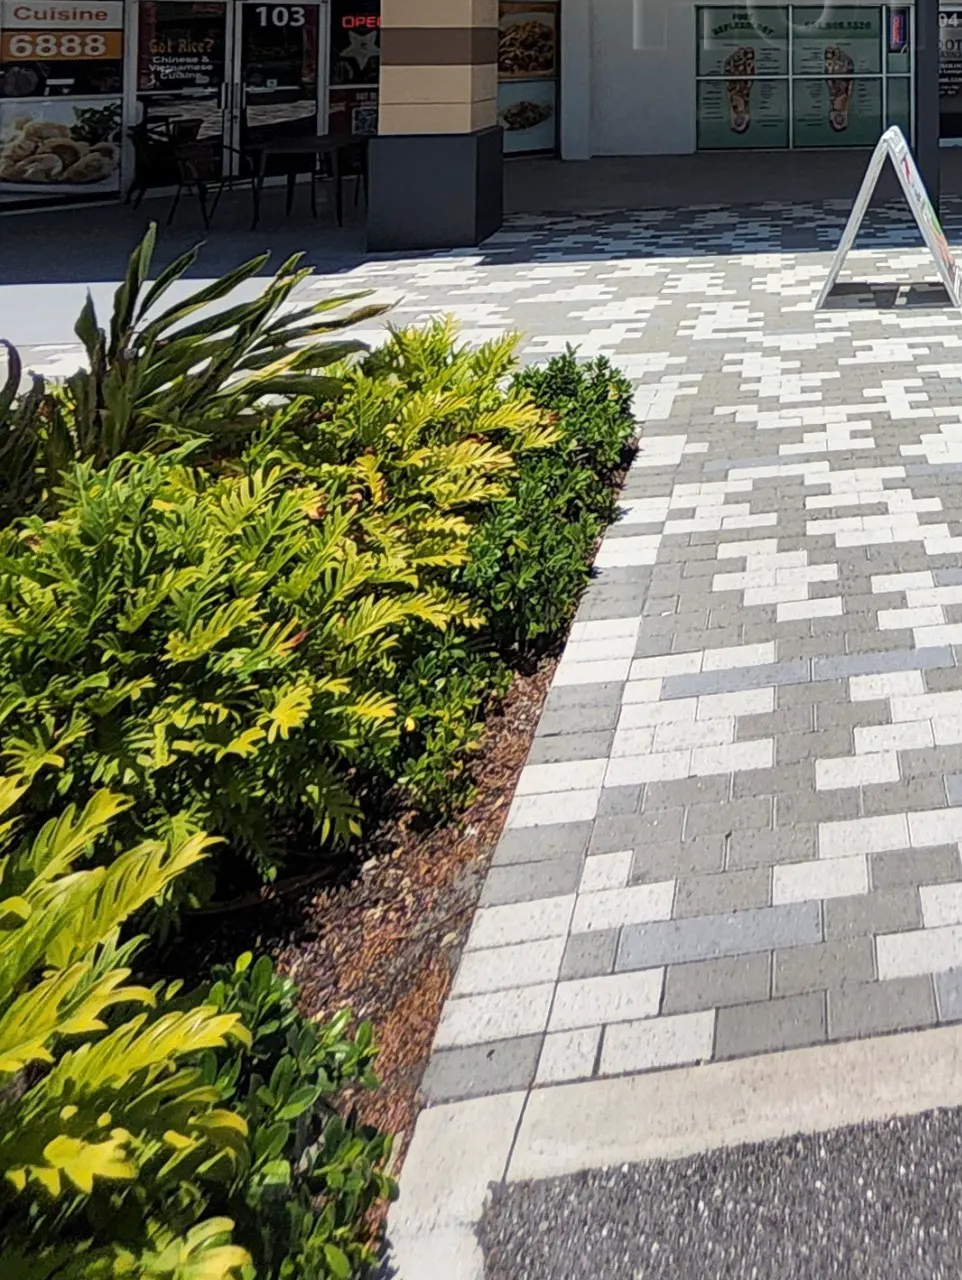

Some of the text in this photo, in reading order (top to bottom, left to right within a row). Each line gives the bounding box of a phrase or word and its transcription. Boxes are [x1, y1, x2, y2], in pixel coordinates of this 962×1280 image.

[13, 6, 108, 21] Cuisine
[255, 6, 306, 27] 103
[938, 12, 959, 27] 04
[9, 34, 107, 57] 6888
[152, 55, 199, 63] Chinese
